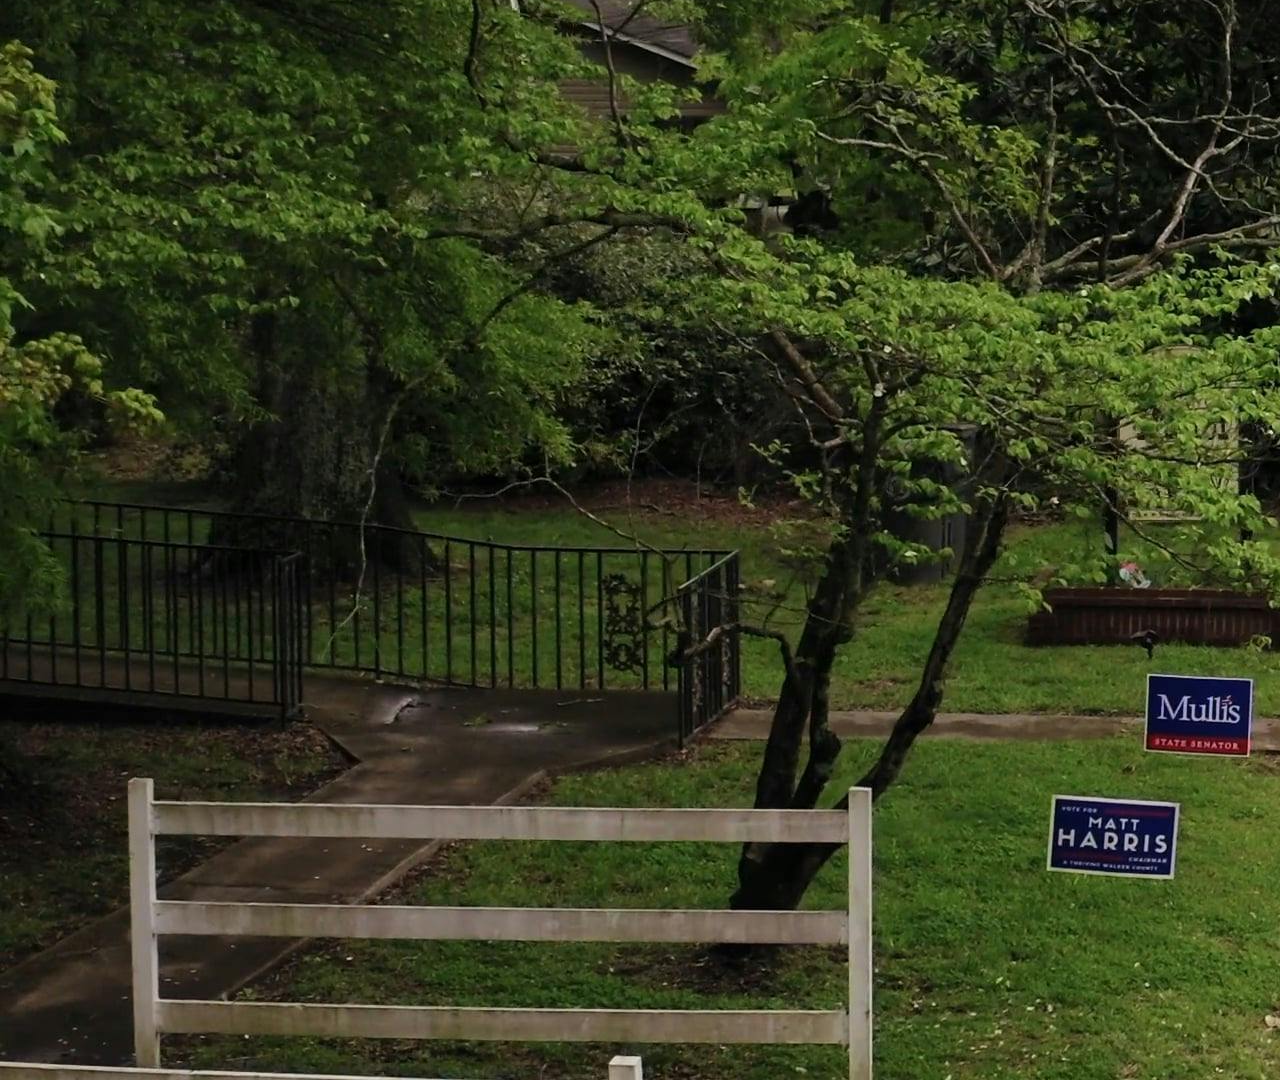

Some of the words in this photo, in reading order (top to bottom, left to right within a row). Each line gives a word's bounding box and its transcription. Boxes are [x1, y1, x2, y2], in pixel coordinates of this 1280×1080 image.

[1156, 693, 1241, 724] Mullis
[1153, 738, 1187, 748] STATE
[1190, 740, 1240, 750] SENATOR
[1088, 816, 1141, 831] MATT
[1057, 828, 1169, 854] HARRIS
